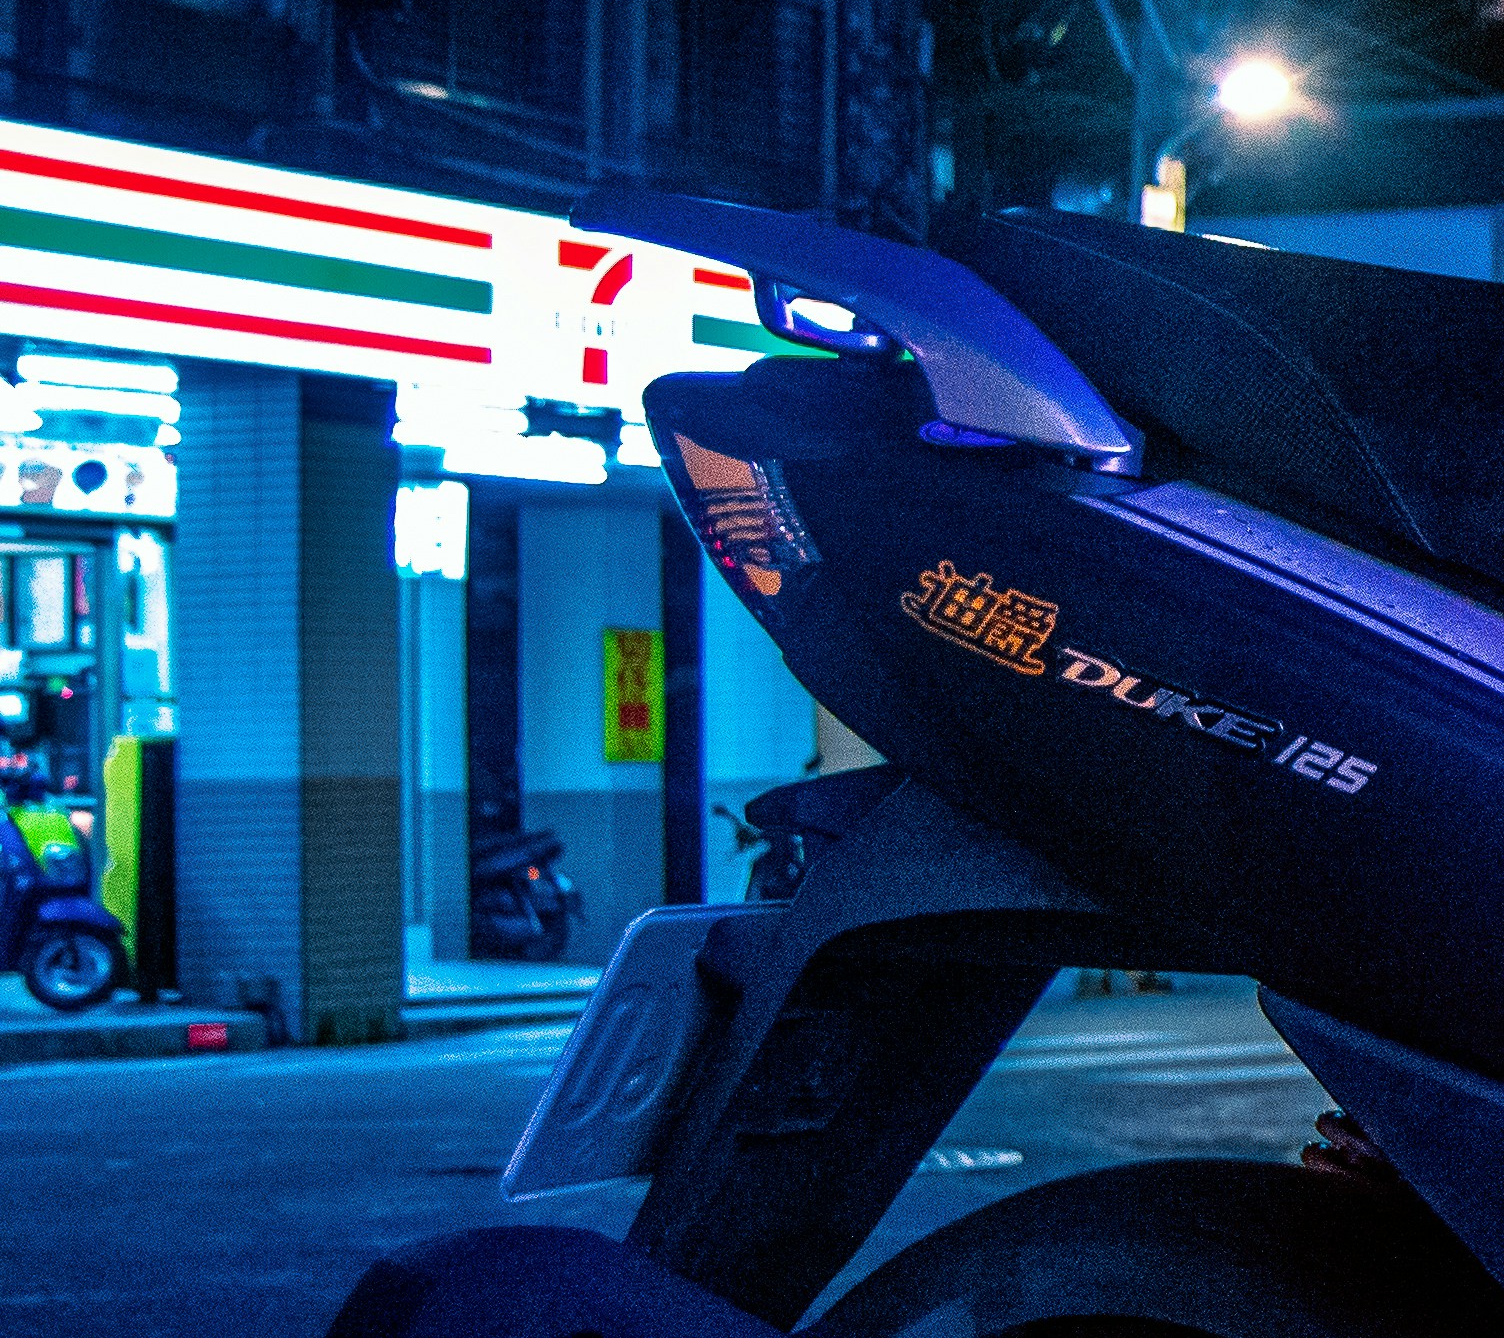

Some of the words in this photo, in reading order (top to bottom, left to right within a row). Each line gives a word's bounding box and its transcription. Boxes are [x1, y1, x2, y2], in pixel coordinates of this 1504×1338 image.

[558, 239, 633, 385] 7
[900, 560, 1059, 676] 迪爵
[1058, 647, 1283, 752] DUKE
[1274, 736, 1378, 794] 125
